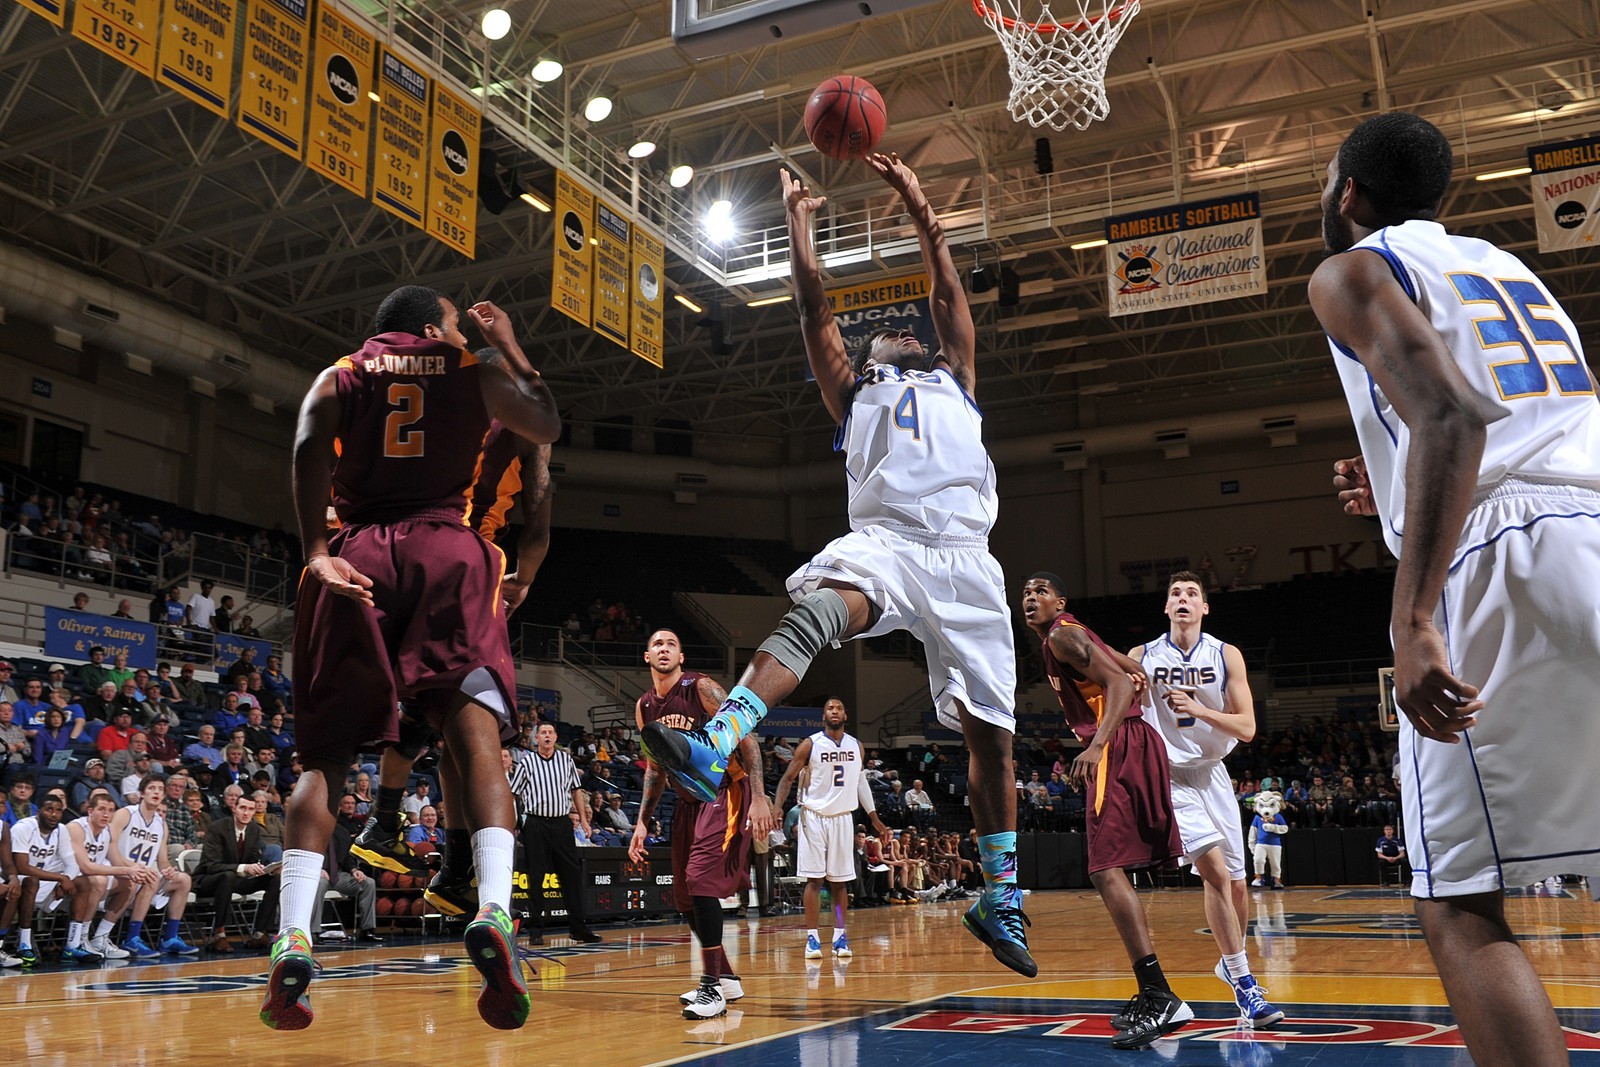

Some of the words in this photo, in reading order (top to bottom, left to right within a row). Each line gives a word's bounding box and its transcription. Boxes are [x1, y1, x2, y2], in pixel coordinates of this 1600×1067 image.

[174, 0, 225, 39] CHAMPION
[255, 5, 277, 32] LONE
[280, 21, 302, 48] STAR
[322, 11, 339, 32] ASU
[91, 17, 139, 56] 1987
[182, 27, 214, 57] 28-11
[249, 22, 303, 69] CONFERENCE
[179, 49, 213, 82] 1989
[253, 45, 298, 85] CHAMPION
[259, 73, 289, 101] 24-17
[330, 71, 358, 100] NCAA
[258, 96, 287, 127] 1991
[384, 90, 402, 114] LONE
[404, 104, 422, 126] STAR
[380, 106, 424, 147] CONFERENCE
[327, 132, 351, 153] 24-17
[383, 127, 420, 161] CHAMPION
[321, 149, 354, 182] 1991
[390, 154, 411, 176] 22-7
[444, 145, 467, 171] NCAA
[1535, 143, 1600, 171] RAMBELLE
[388, 173, 413, 201] 1992
[437, 217, 466, 246] 1992
[1110, 213, 1180, 240] RAMBELLE
[1186, 201, 1256, 226] SOFTBALL
[1558, 211, 1587, 224] NCAA
[565, 225, 584, 245] NCAA
[1165, 227, 1254, 259] National
[1127, 267, 1152, 279] NCAA
[1166, 255, 1260, 286] Champions
[562, 293, 580, 314] 2011
[844, 280, 926, 308] BASKETBALL
[1116, 297, 1155, 310] ANGELO
[1161, 291, 1190, 303] STATE
[1198, 281, 1261, 297] UNIVERSITY
[603, 306, 620, 326] 2012
[834, 303, 921, 328] NJCAA
[637, 338, 658, 359] 2012
[1443, 270, 1595, 401] 35
[364, 354, 446, 375] PLUMMER
[384, 382, 425, 458] 2
[892, 384, 922, 442] 4
[58, 618, 99, 637] Oliver,
[103, 626, 145, 645] Rainey
[75, 640, 84, 651] &
[1153, 666, 1217, 685] RAMS
[656, 714, 695, 731] ESTERN
[762, 719, 802, 728] Livestock
[820, 751, 855, 763] RAMS
[833, 765, 845, 787] 2
[129, 843, 154, 866] 44
[595, 875, 611, 885] RAMS
